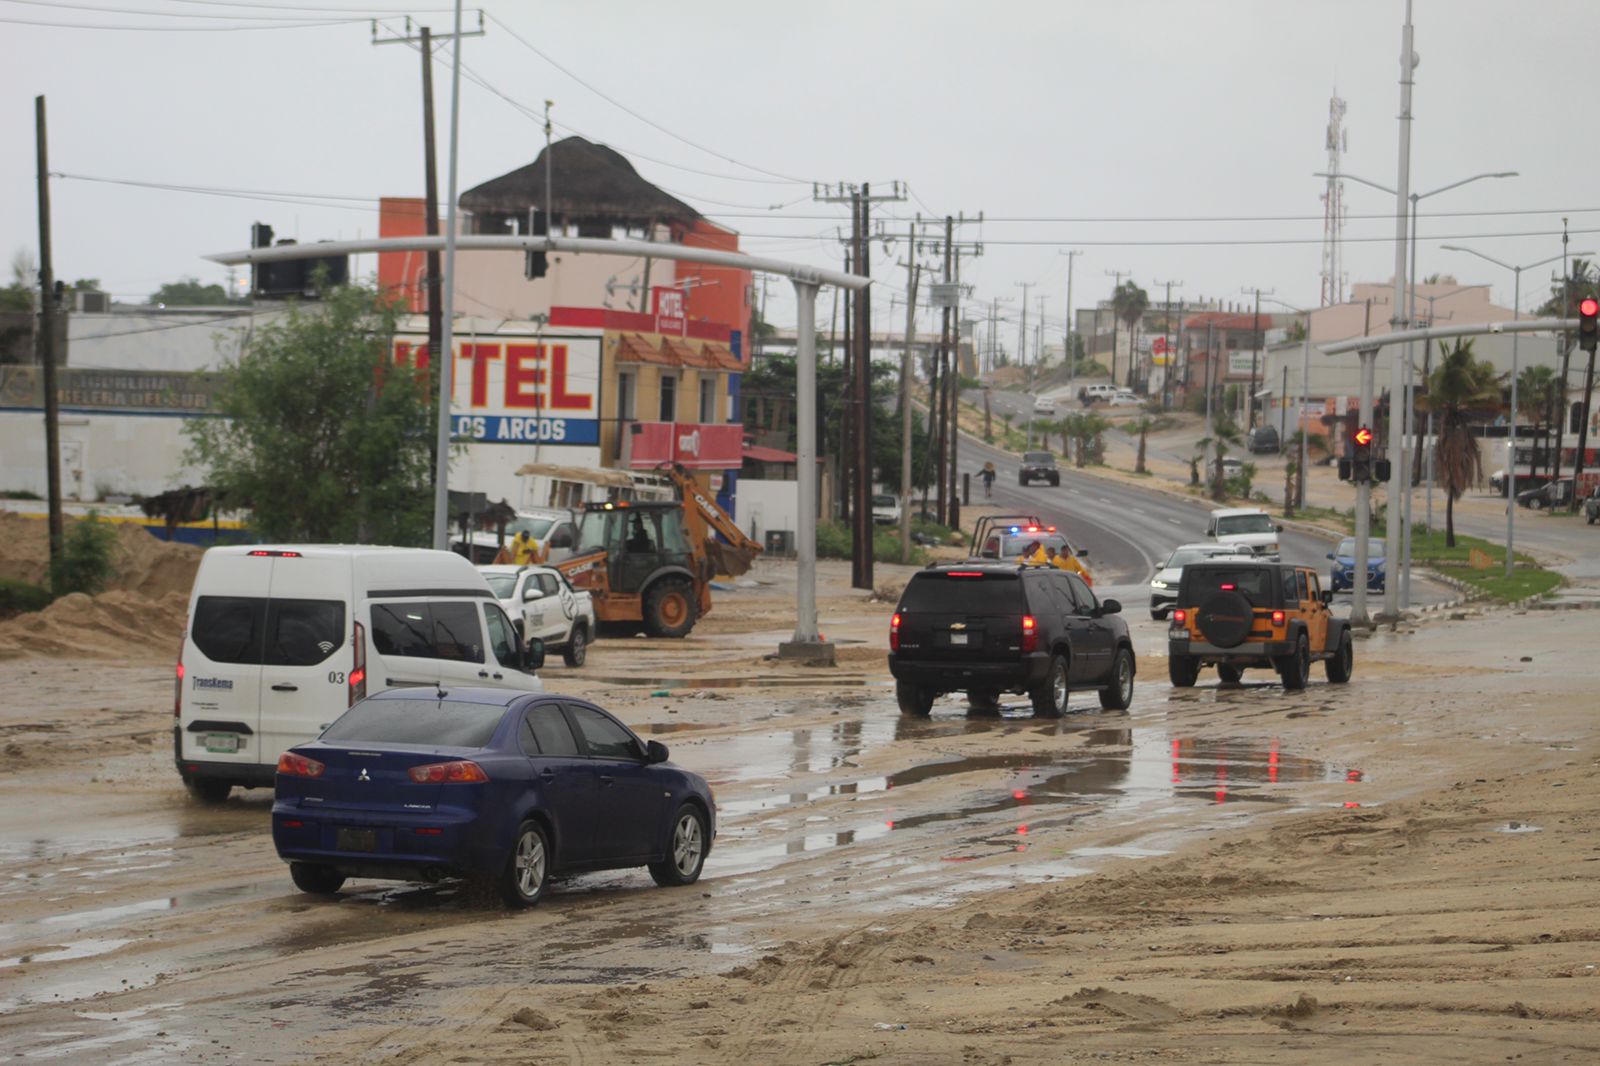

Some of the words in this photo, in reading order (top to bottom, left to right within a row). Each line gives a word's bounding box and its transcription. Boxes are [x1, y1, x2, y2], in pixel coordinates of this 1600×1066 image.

[659, 291, 684, 318] HOTEL
[497, 417, 566, 440] ARCOS
[695, 494, 720, 519] CASE
[568, 561, 592, 577] CASE
[192, 676, 234, 692] TransKema
[328, 671, 345, 685] 03
